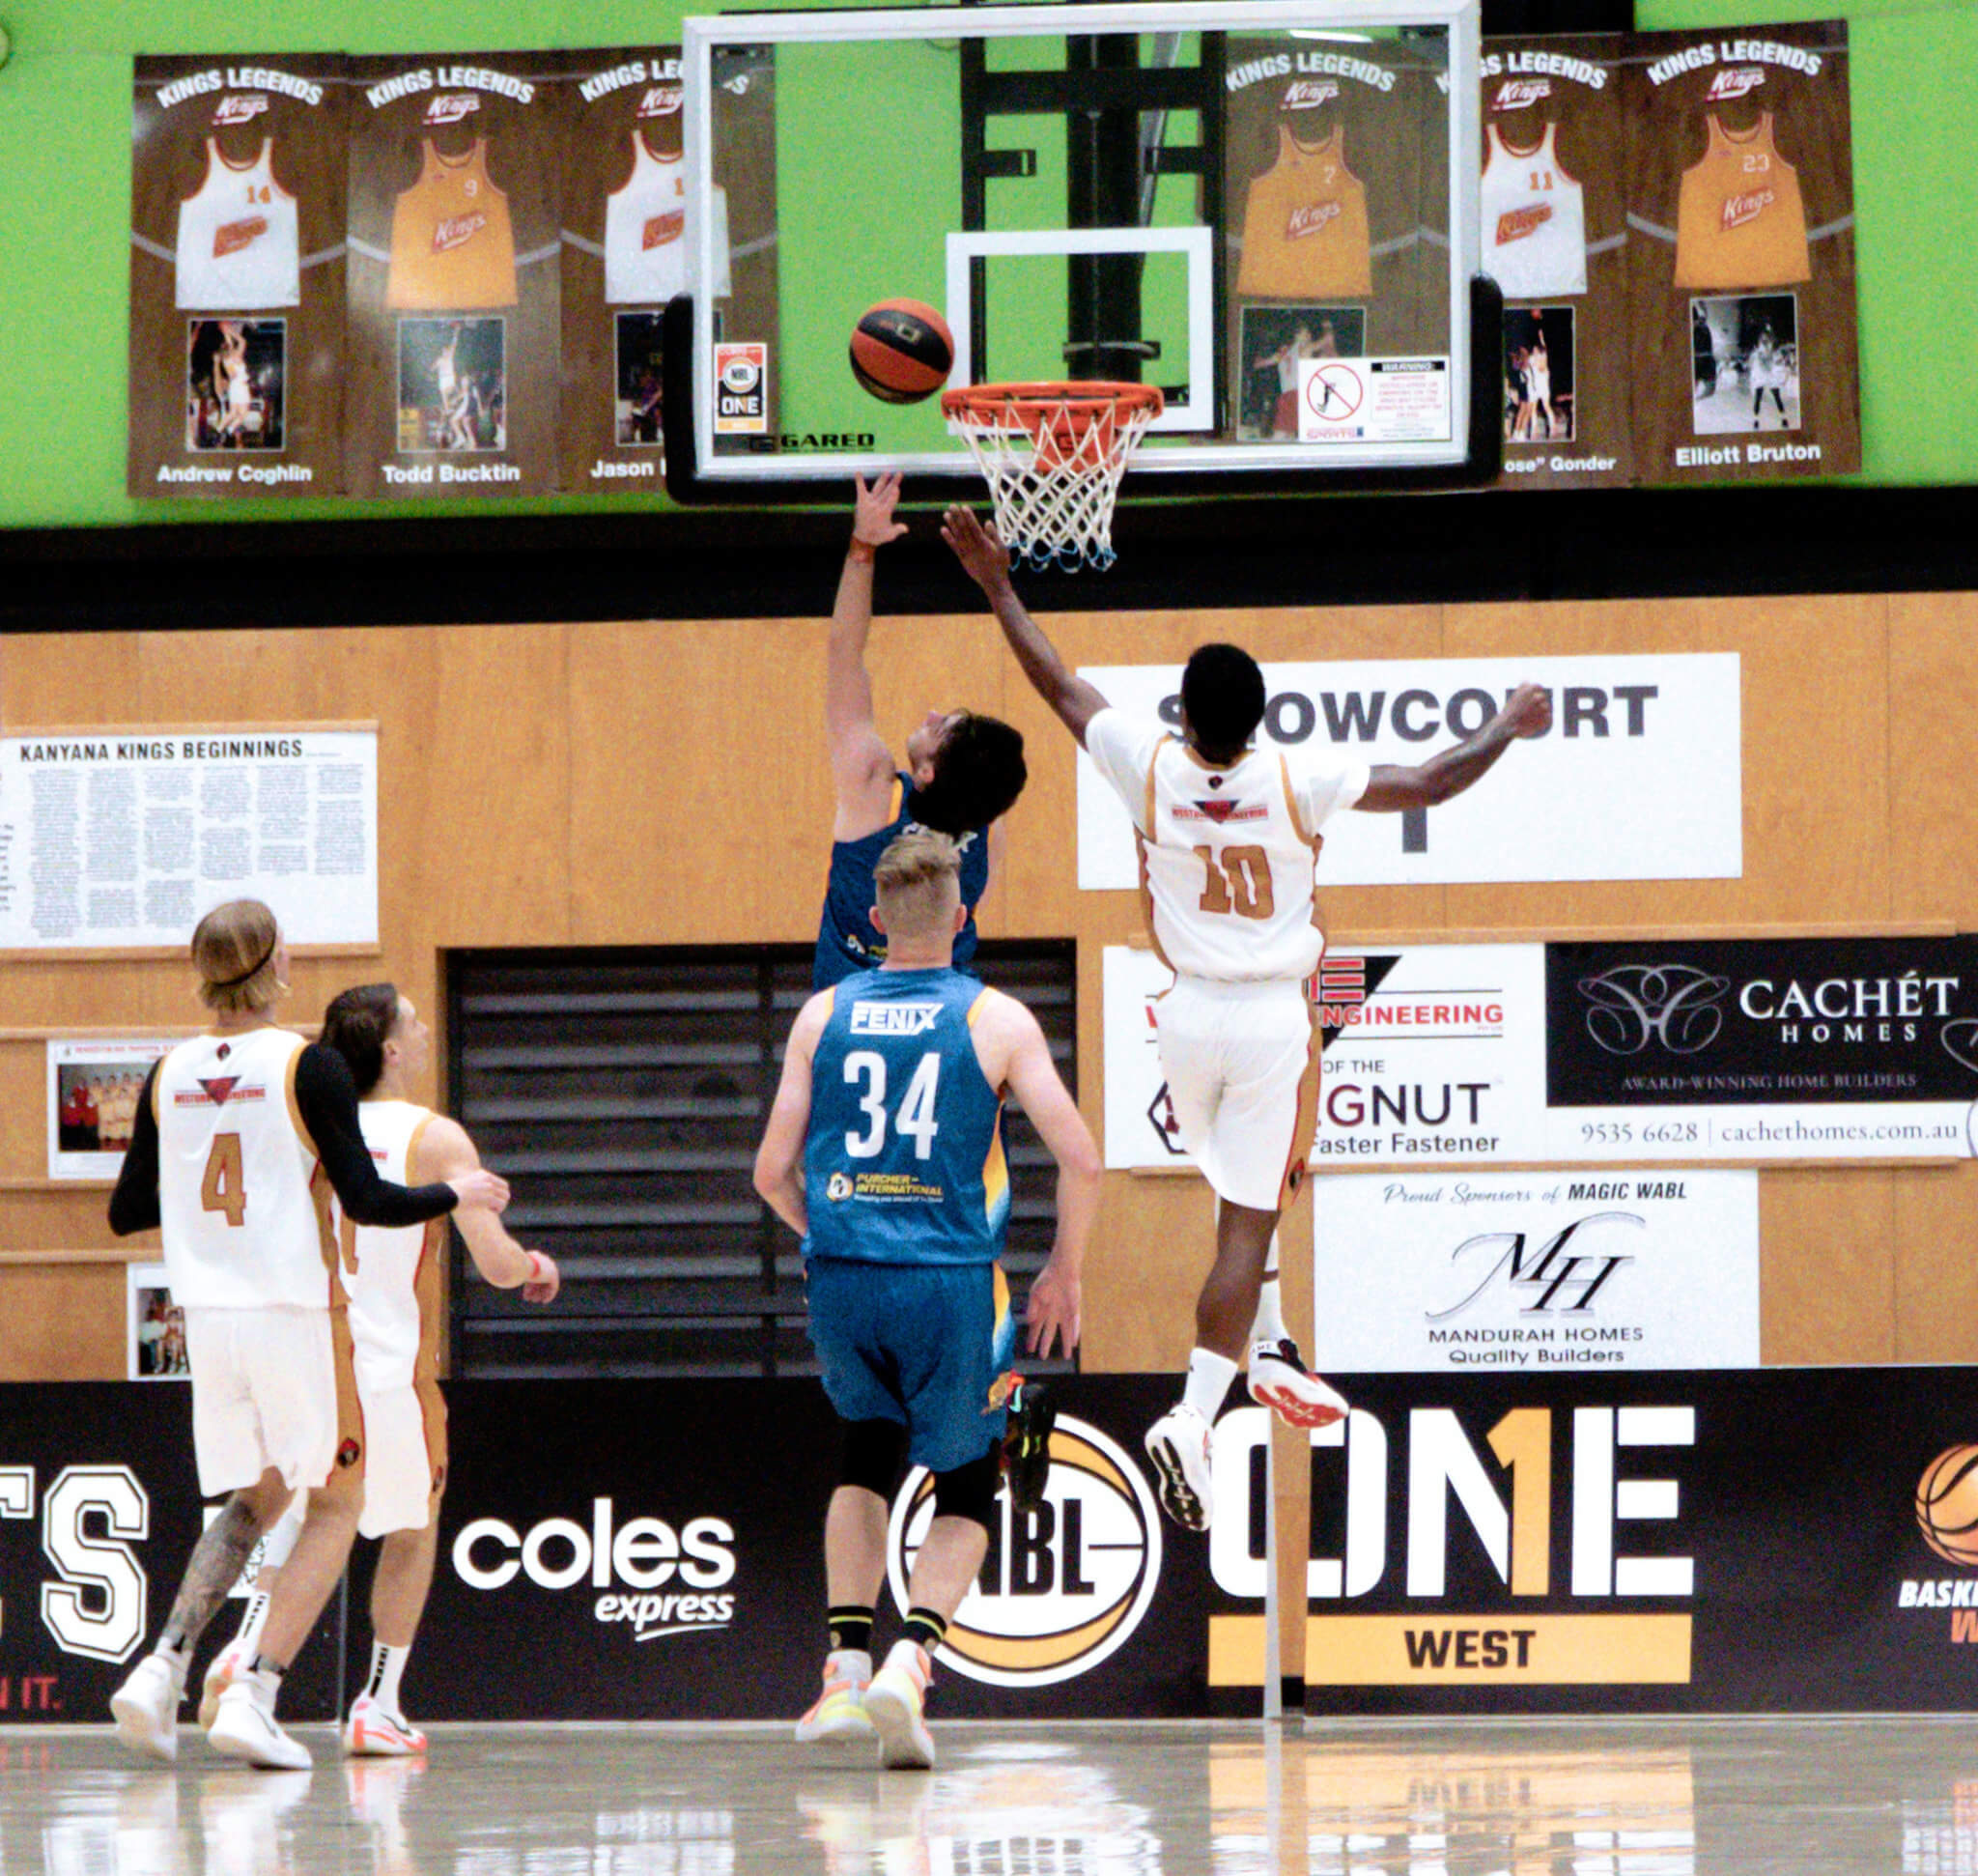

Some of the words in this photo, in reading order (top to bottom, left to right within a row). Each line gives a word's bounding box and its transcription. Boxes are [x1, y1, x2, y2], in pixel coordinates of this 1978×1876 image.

[1226, 53, 1292, 92] KINGS
[1296, 51, 1397, 92] LEGENDS
[1507, 51, 1608, 90] LEGENDS
[1647, 43, 1715, 86] KINGS
[1720, 40, 1822, 76] LEGENDS
[156, 69, 222, 108] KINGS
[226, 67, 324, 106] LEGENDS
[366, 69, 433, 108] KINGS
[438, 66, 536, 104] LEGENDS
[579, 61, 646, 102] KINGS
[1742, 154, 1770, 174] 23
[464, 179, 479, 198] 9
[1529, 171, 1554, 191] 11
[721, 396, 759, 414] ONE
[780, 434, 874, 447] GARED
[1550, 456, 1617, 472] Gonder
[1676, 447, 1741, 467] Elliott
[1746, 443, 1822, 464] Bruton
[156, 465, 232, 482] Andrew
[238, 464, 312, 485] Coghlin
[382, 465, 432, 483] Todd
[439, 464, 521, 483] Bucktin
[590, 459, 655, 478] Jason
[20, 744, 109, 762] KANYANA
[117, 742, 175, 760] KINGS
[184, 740, 302, 759] BEGINNINGS
[1193, 844, 1275, 920] 10
[1739, 970, 1960, 1019] CACHÉT
[850, 1001, 945, 1036] FENIX
[1322, 1005, 1504, 1027] NGINEERING
[1781, 1023, 1916, 1044] HOMES
[1351, 1060, 1384, 1073] THE
[1622, 1074, 1772, 1091] AWARD-WINNING
[1777, 1074, 1828, 1089] HOME
[1833, 1072, 1917, 1088] BUILDERS
[843, 1051, 941, 1159] 34
[1318, 1083, 1490, 1126] GNUT
[1314, 1133, 1382, 1153] aster
[1391, 1132, 1499, 1153] Fastener
[1581, 1123, 1633, 1144] 9535
[1643, 1121, 1699, 1143] 6628
[1721, 1120, 1959, 1142] cachethomes.com.au
[201, 1132, 246, 1227] 4
[1383, 1182, 1443, 1205] Proud
[1450, 1181, 1531, 1206] Sponsors
[1540, 1184, 1561, 1205] of
[1568, 1182, 1630, 1200] MAGIC
[1636, 1181, 1687, 1199] WABL
[1428, 1330, 1557, 1344] MANDURAH
[1564, 1327, 1644, 1343] HOMES
[1449, 1350, 1528, 1366] Quality
[1537, 1349, 1625, 1363] Builders
[1209, 1406, 1697, 1599] ONE
[452, 1497, 736, 1589] coles
[594, 1594, 736, 1632] express
[1403, 1629, 1538, 1668] WEST
